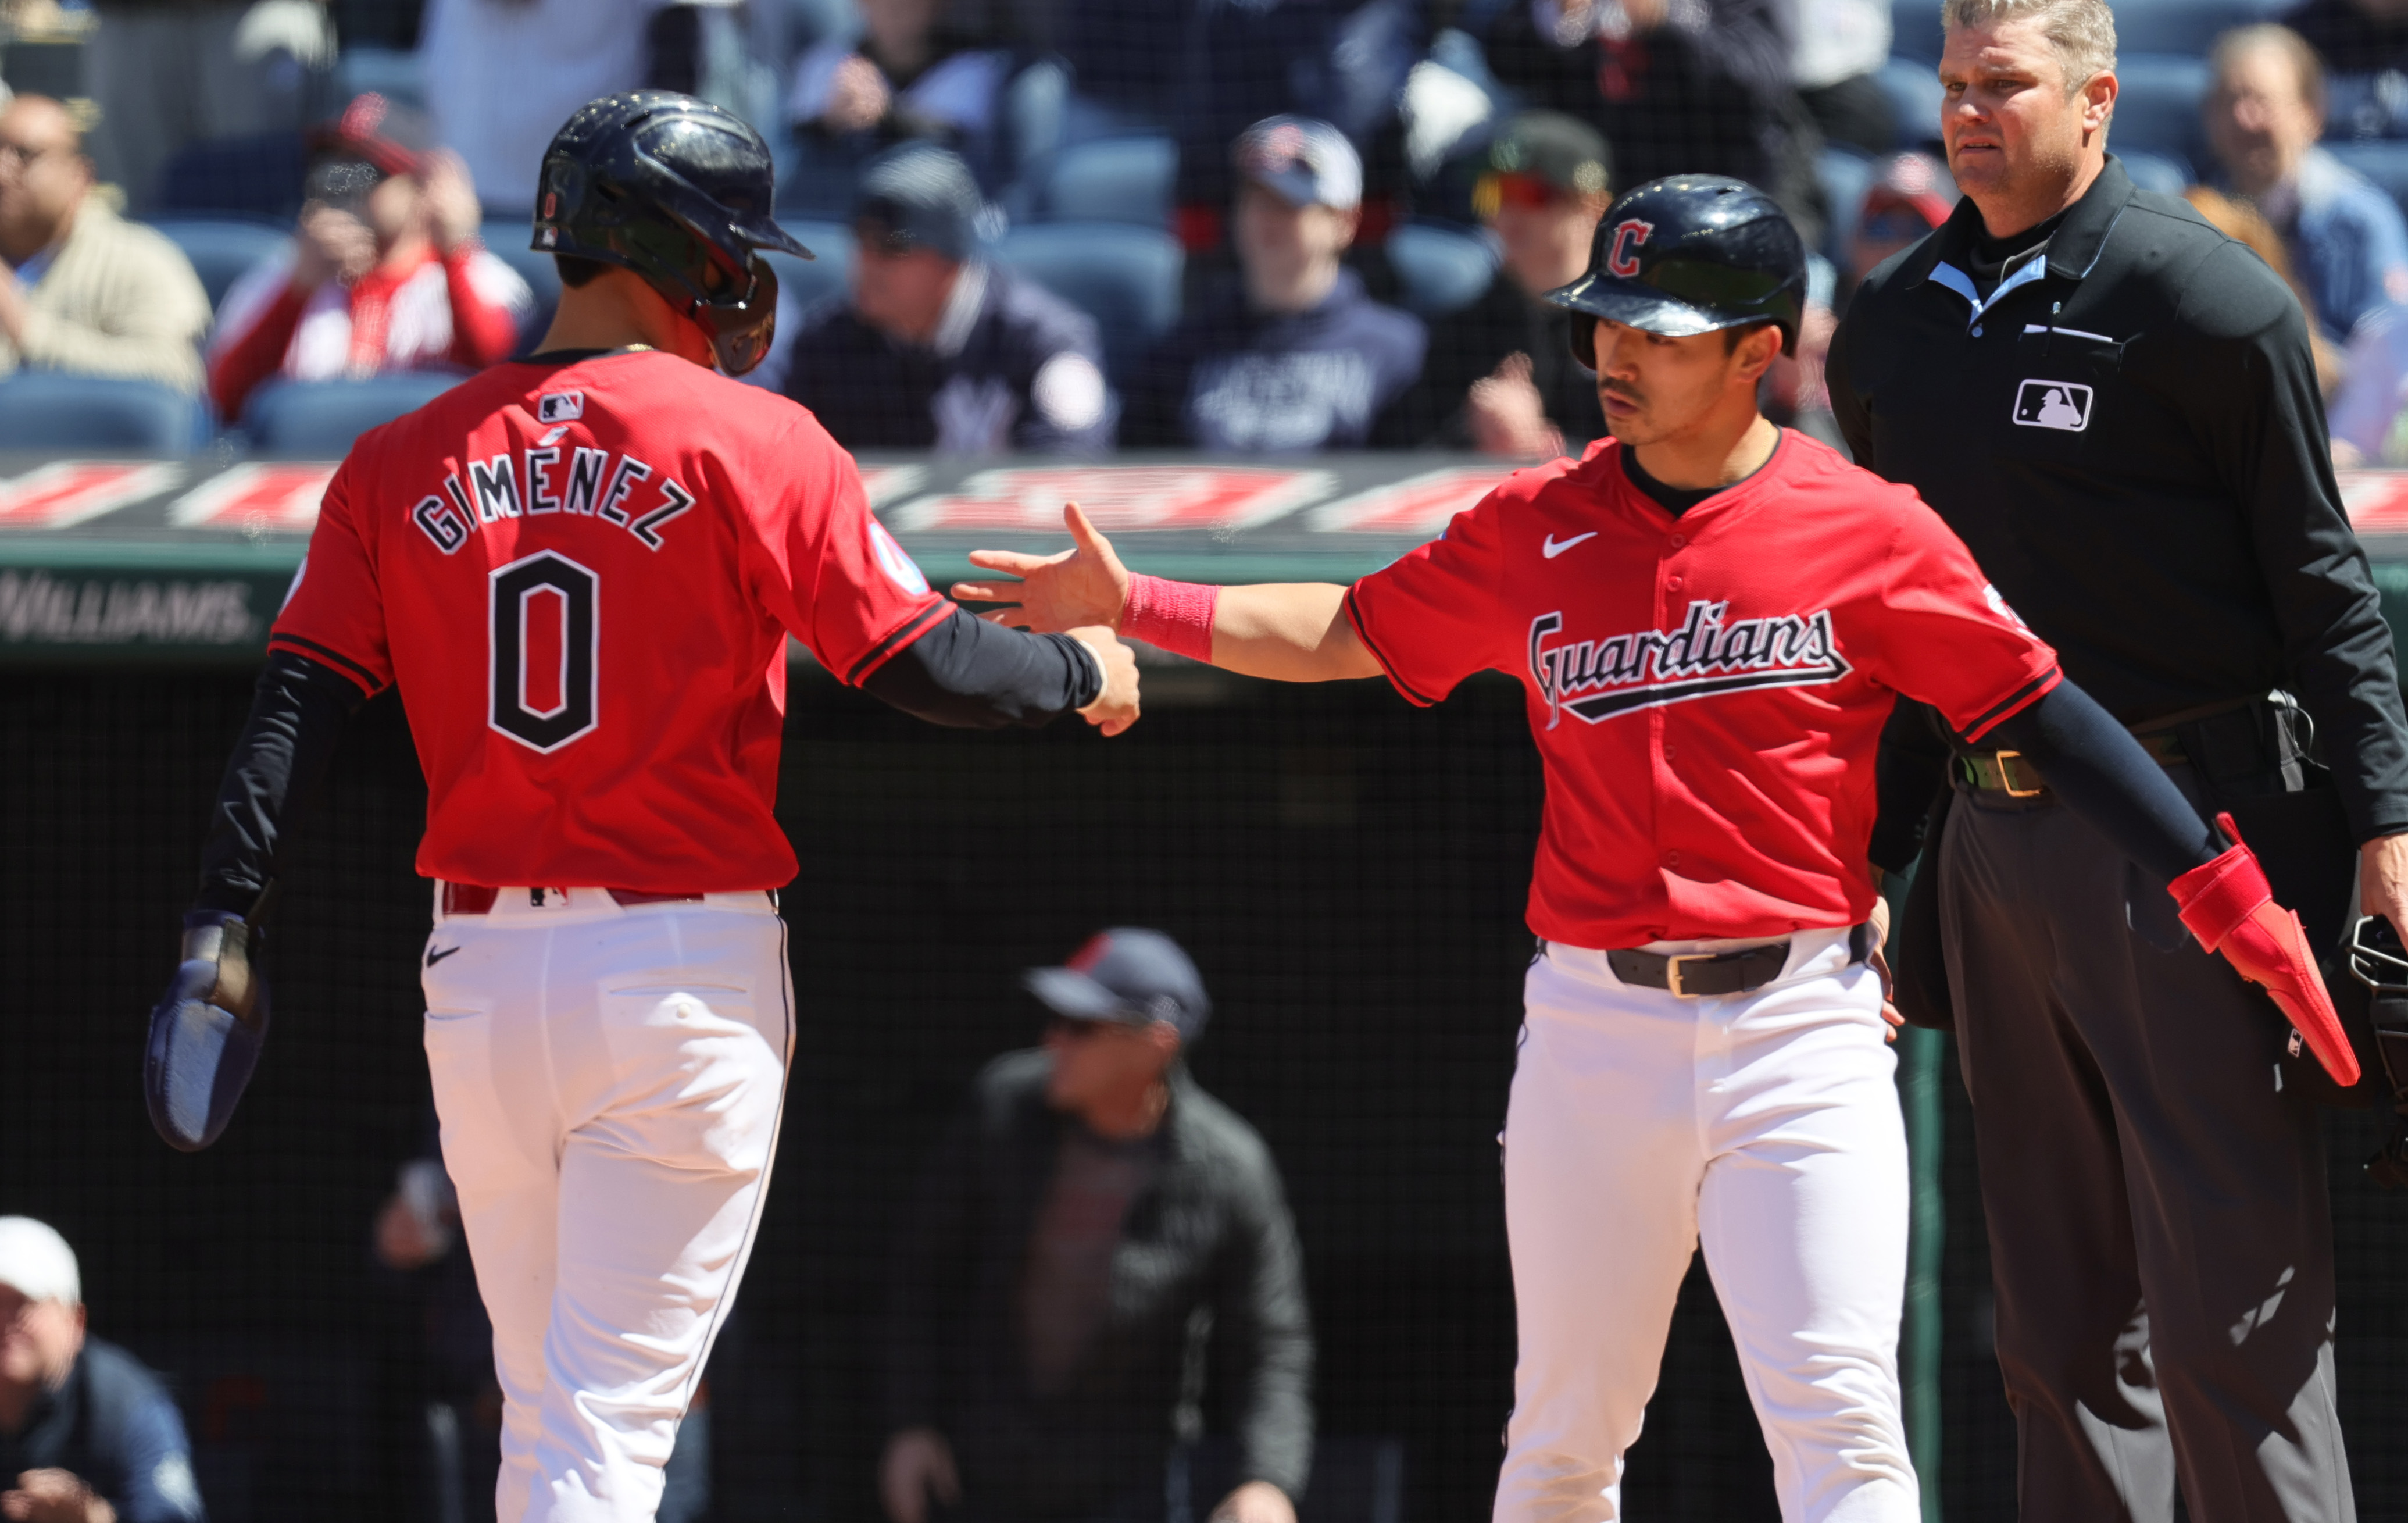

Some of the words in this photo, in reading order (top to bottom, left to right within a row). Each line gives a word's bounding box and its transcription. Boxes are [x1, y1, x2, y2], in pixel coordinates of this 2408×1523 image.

[1608, 218, 1655, 278] C
[487, 548, 599, 755] 0
[1528, 600, 1853, 731] Guardians
